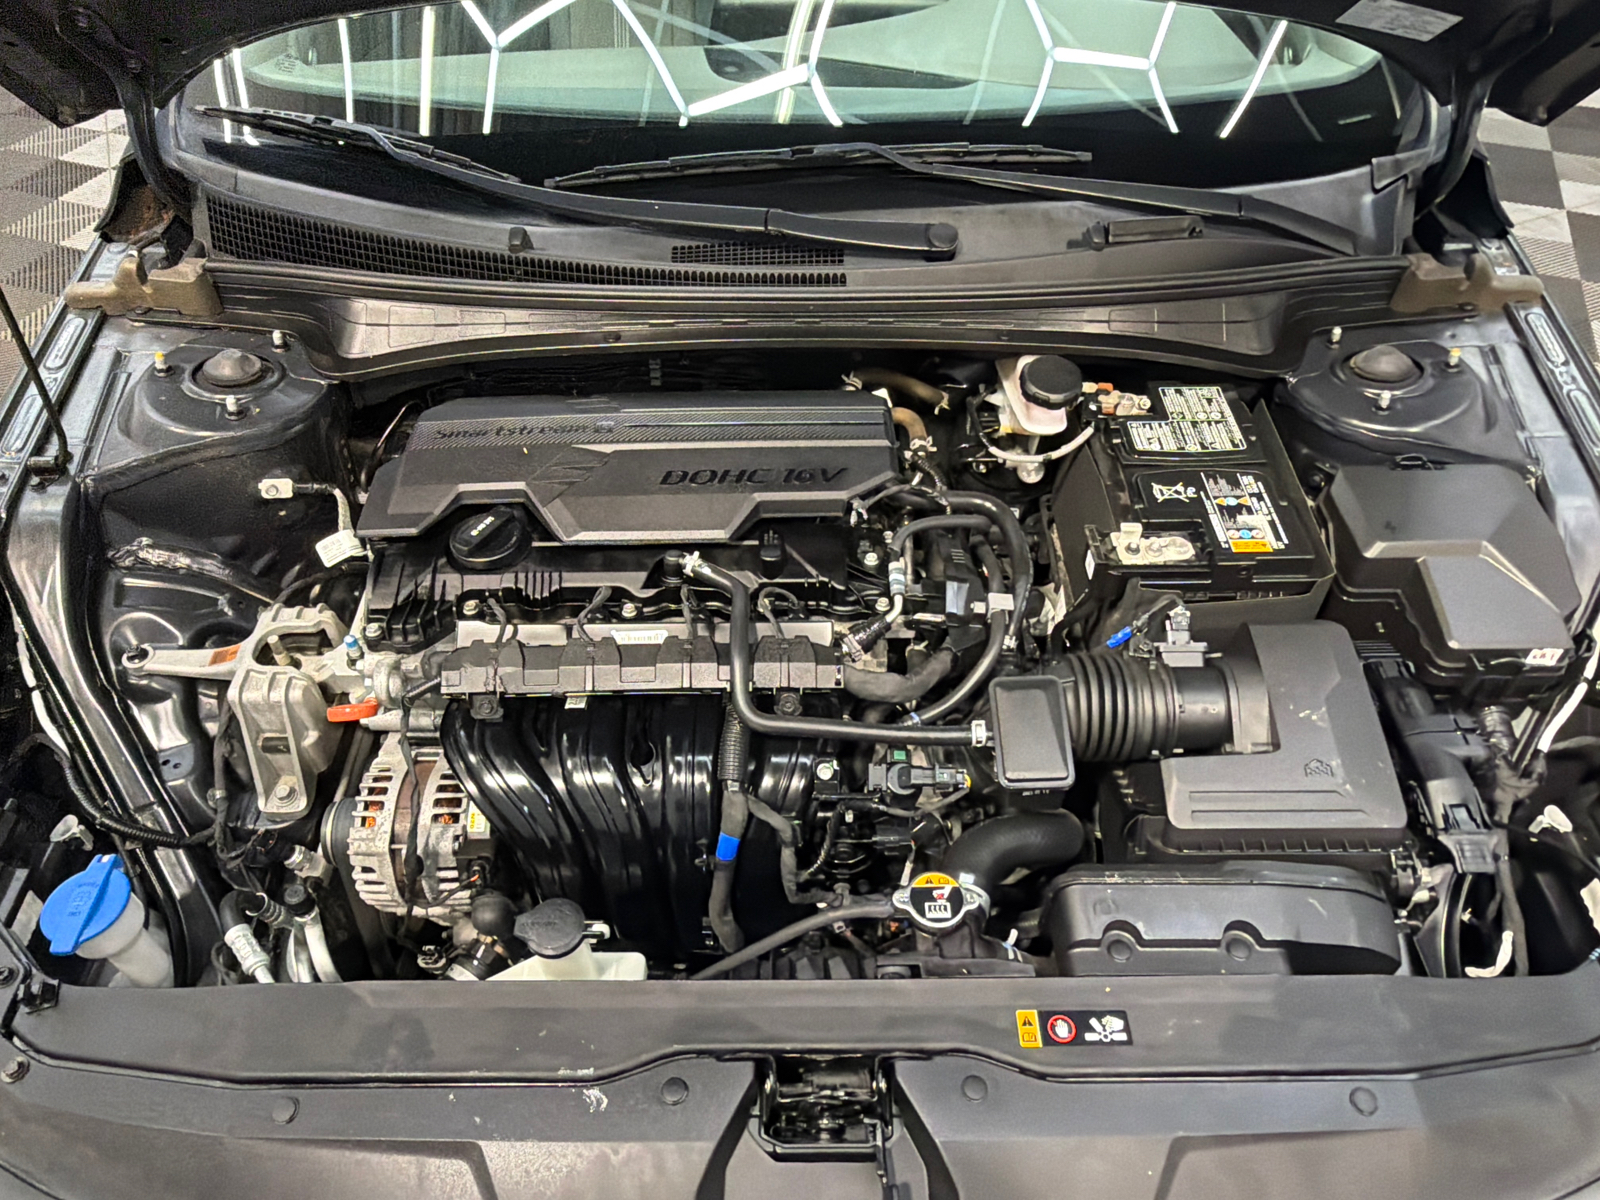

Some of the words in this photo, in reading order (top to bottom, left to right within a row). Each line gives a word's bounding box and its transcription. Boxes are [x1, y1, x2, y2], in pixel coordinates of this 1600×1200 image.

[434, 424, 588, 440] Smartstream
[660, 468, 773, 485] DOHC
[782, 467, 848, 484] 16V
